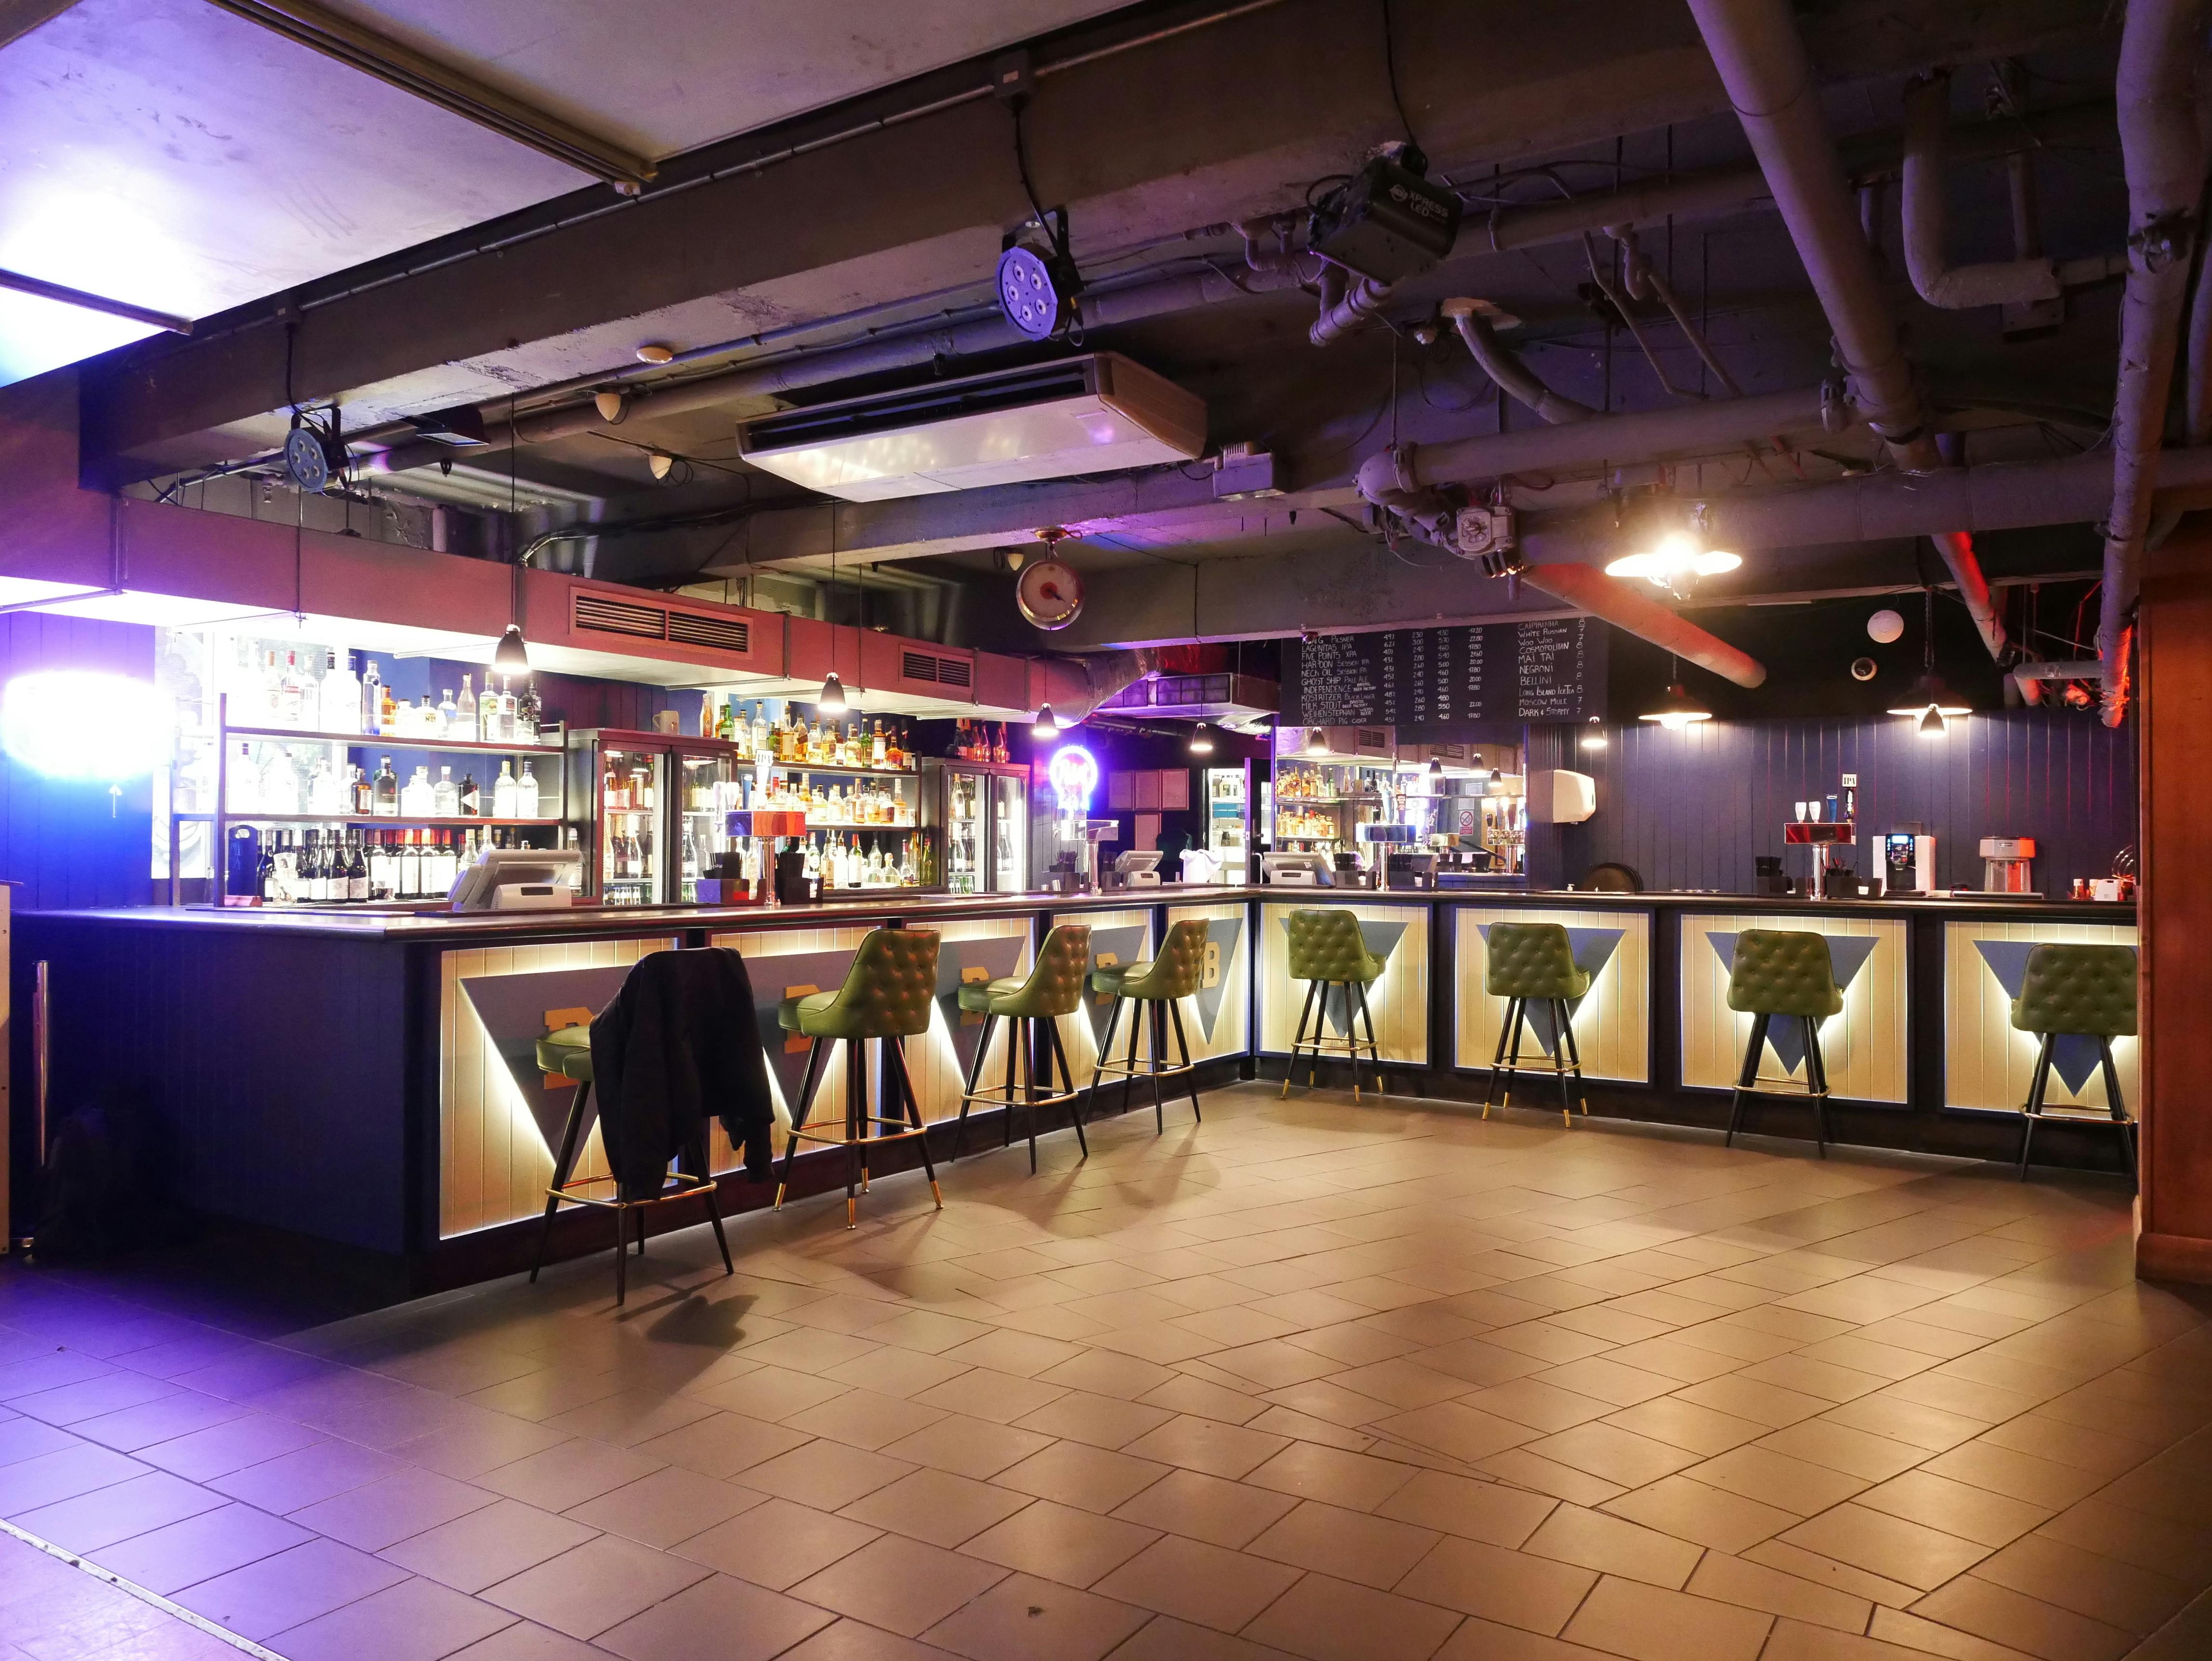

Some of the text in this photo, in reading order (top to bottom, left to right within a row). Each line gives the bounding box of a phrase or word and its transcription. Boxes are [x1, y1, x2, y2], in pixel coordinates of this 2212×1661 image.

[1410, 201, 1429, 217] LED
[1518, 620, 1559, 630] CAIPIRINHA
[1331, 635, 1355, 643] PILSNER
[1518, 638, 1534, 646] WOO
[1519, 642, 1569, 654] COSMOPOLITAN
[1318, 651, 1341, 660] POINTS
[1518, 653, 1535, 664] MAI
[1540, 651, 1554, 662] TAI
[1519, 662, 1554, 674] NEGRONI
[1301, 678, 1324, 686] GHOST
[1326, 676, 1341, 685] SHIP
[1520, 675, 1552, 686] BELLINI
[1304, 684, 1353, 694] INDEPENDENCE
[1519, 687, 1534, 697] LONG
[1537, 685, 1556, 696] ISLAND
[1302, 702, 1317, 711] MILK
[1320, 701, 1342, 710] STOUT
[1519, 699, 1547, 707] MOSCOW
[1518, 708, 1539, 717] DARK
[1546, 707, 1570, 715] STORMY
